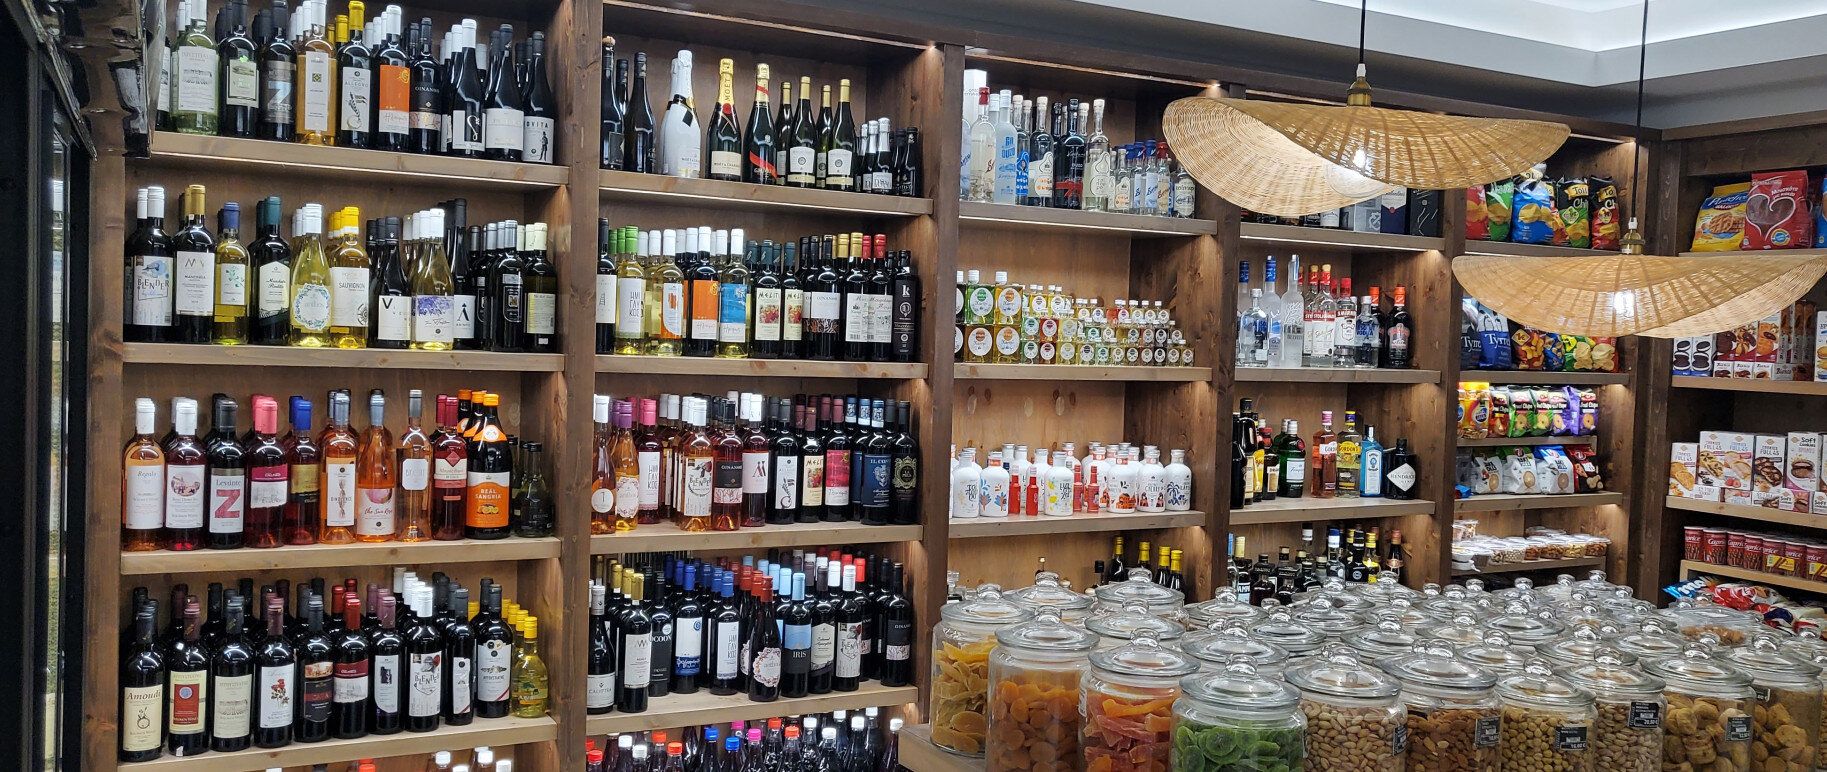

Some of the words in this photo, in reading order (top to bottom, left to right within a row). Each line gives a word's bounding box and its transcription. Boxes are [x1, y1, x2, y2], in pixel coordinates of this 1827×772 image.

[137, 278, 170, 290] BLENDER
[215, 489, 241, 518] Z
[793, 651, 807, 659] IRIS
